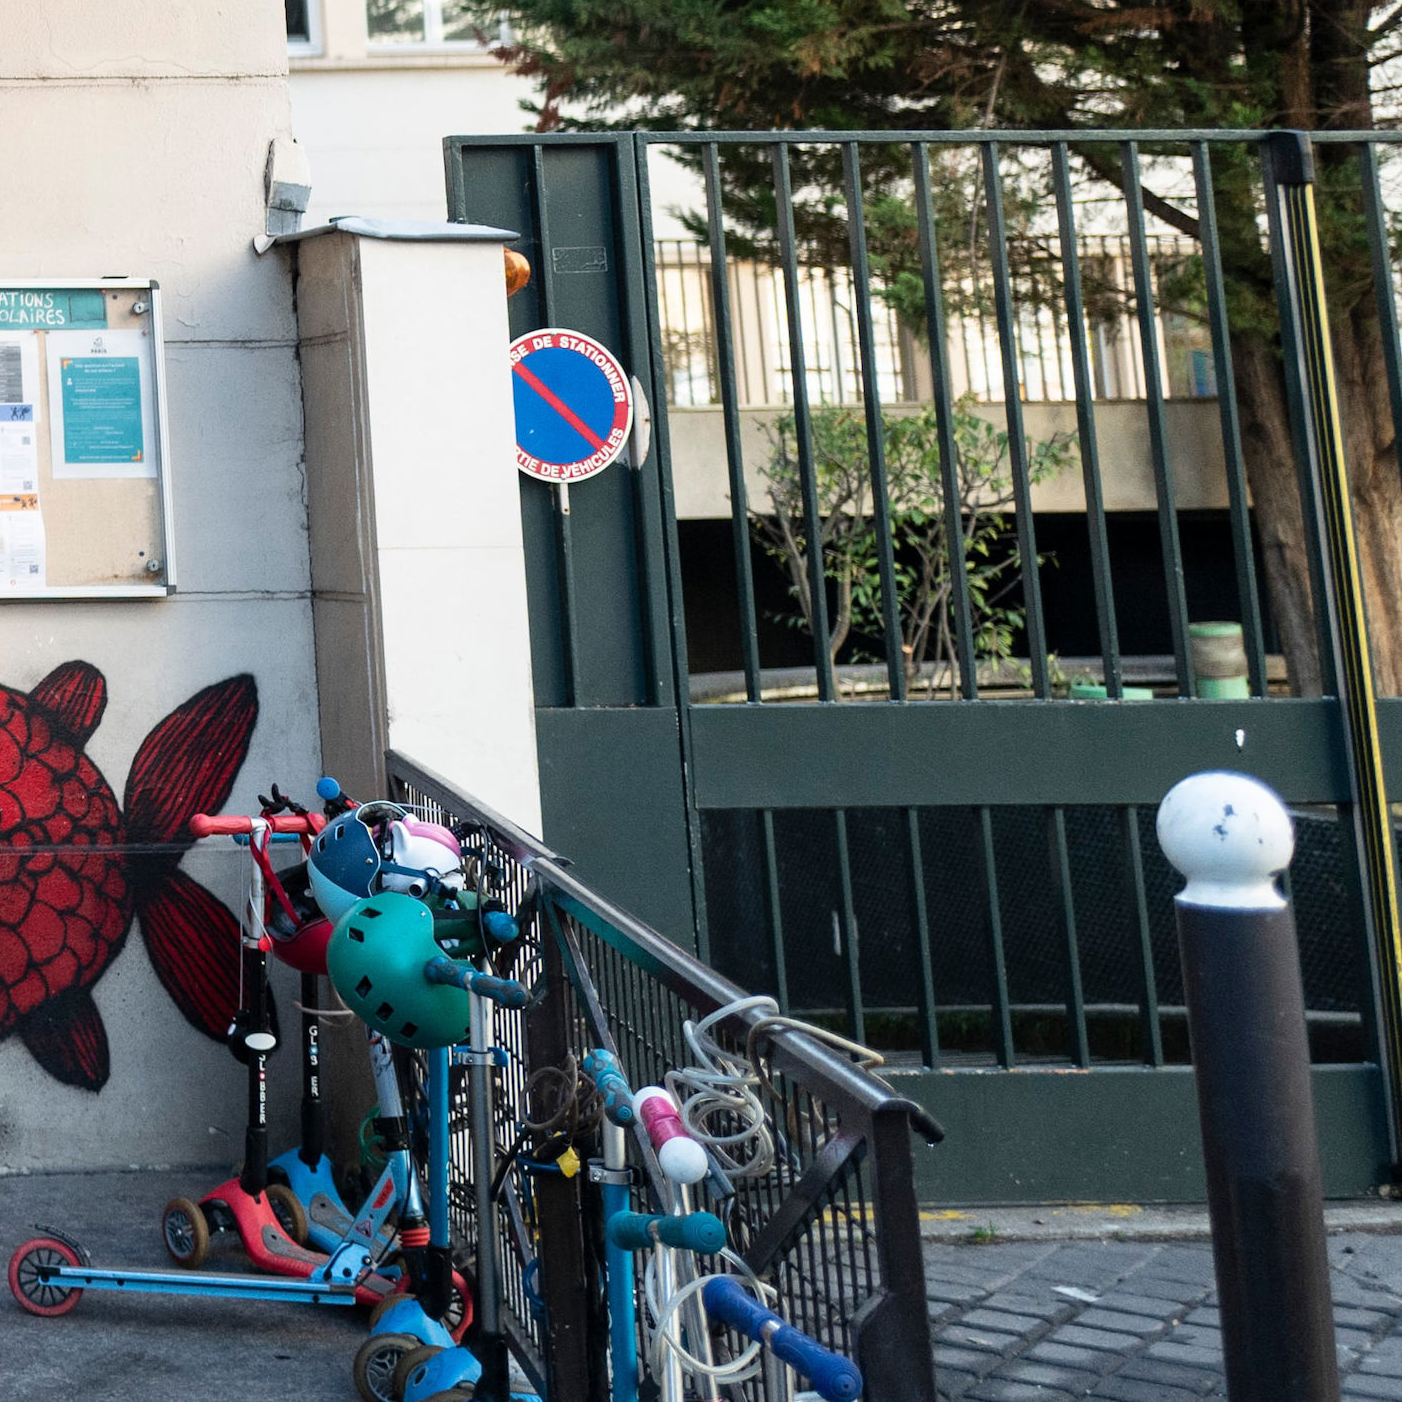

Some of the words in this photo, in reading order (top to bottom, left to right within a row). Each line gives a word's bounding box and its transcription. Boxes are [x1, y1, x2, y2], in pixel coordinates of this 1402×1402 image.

[532, 335, 553, 351] DE
[559, 335, 626, 404] STATIONNER
[540, 462, 562, 478] DE
[562, 426, 625, 478] VÉHICULES
